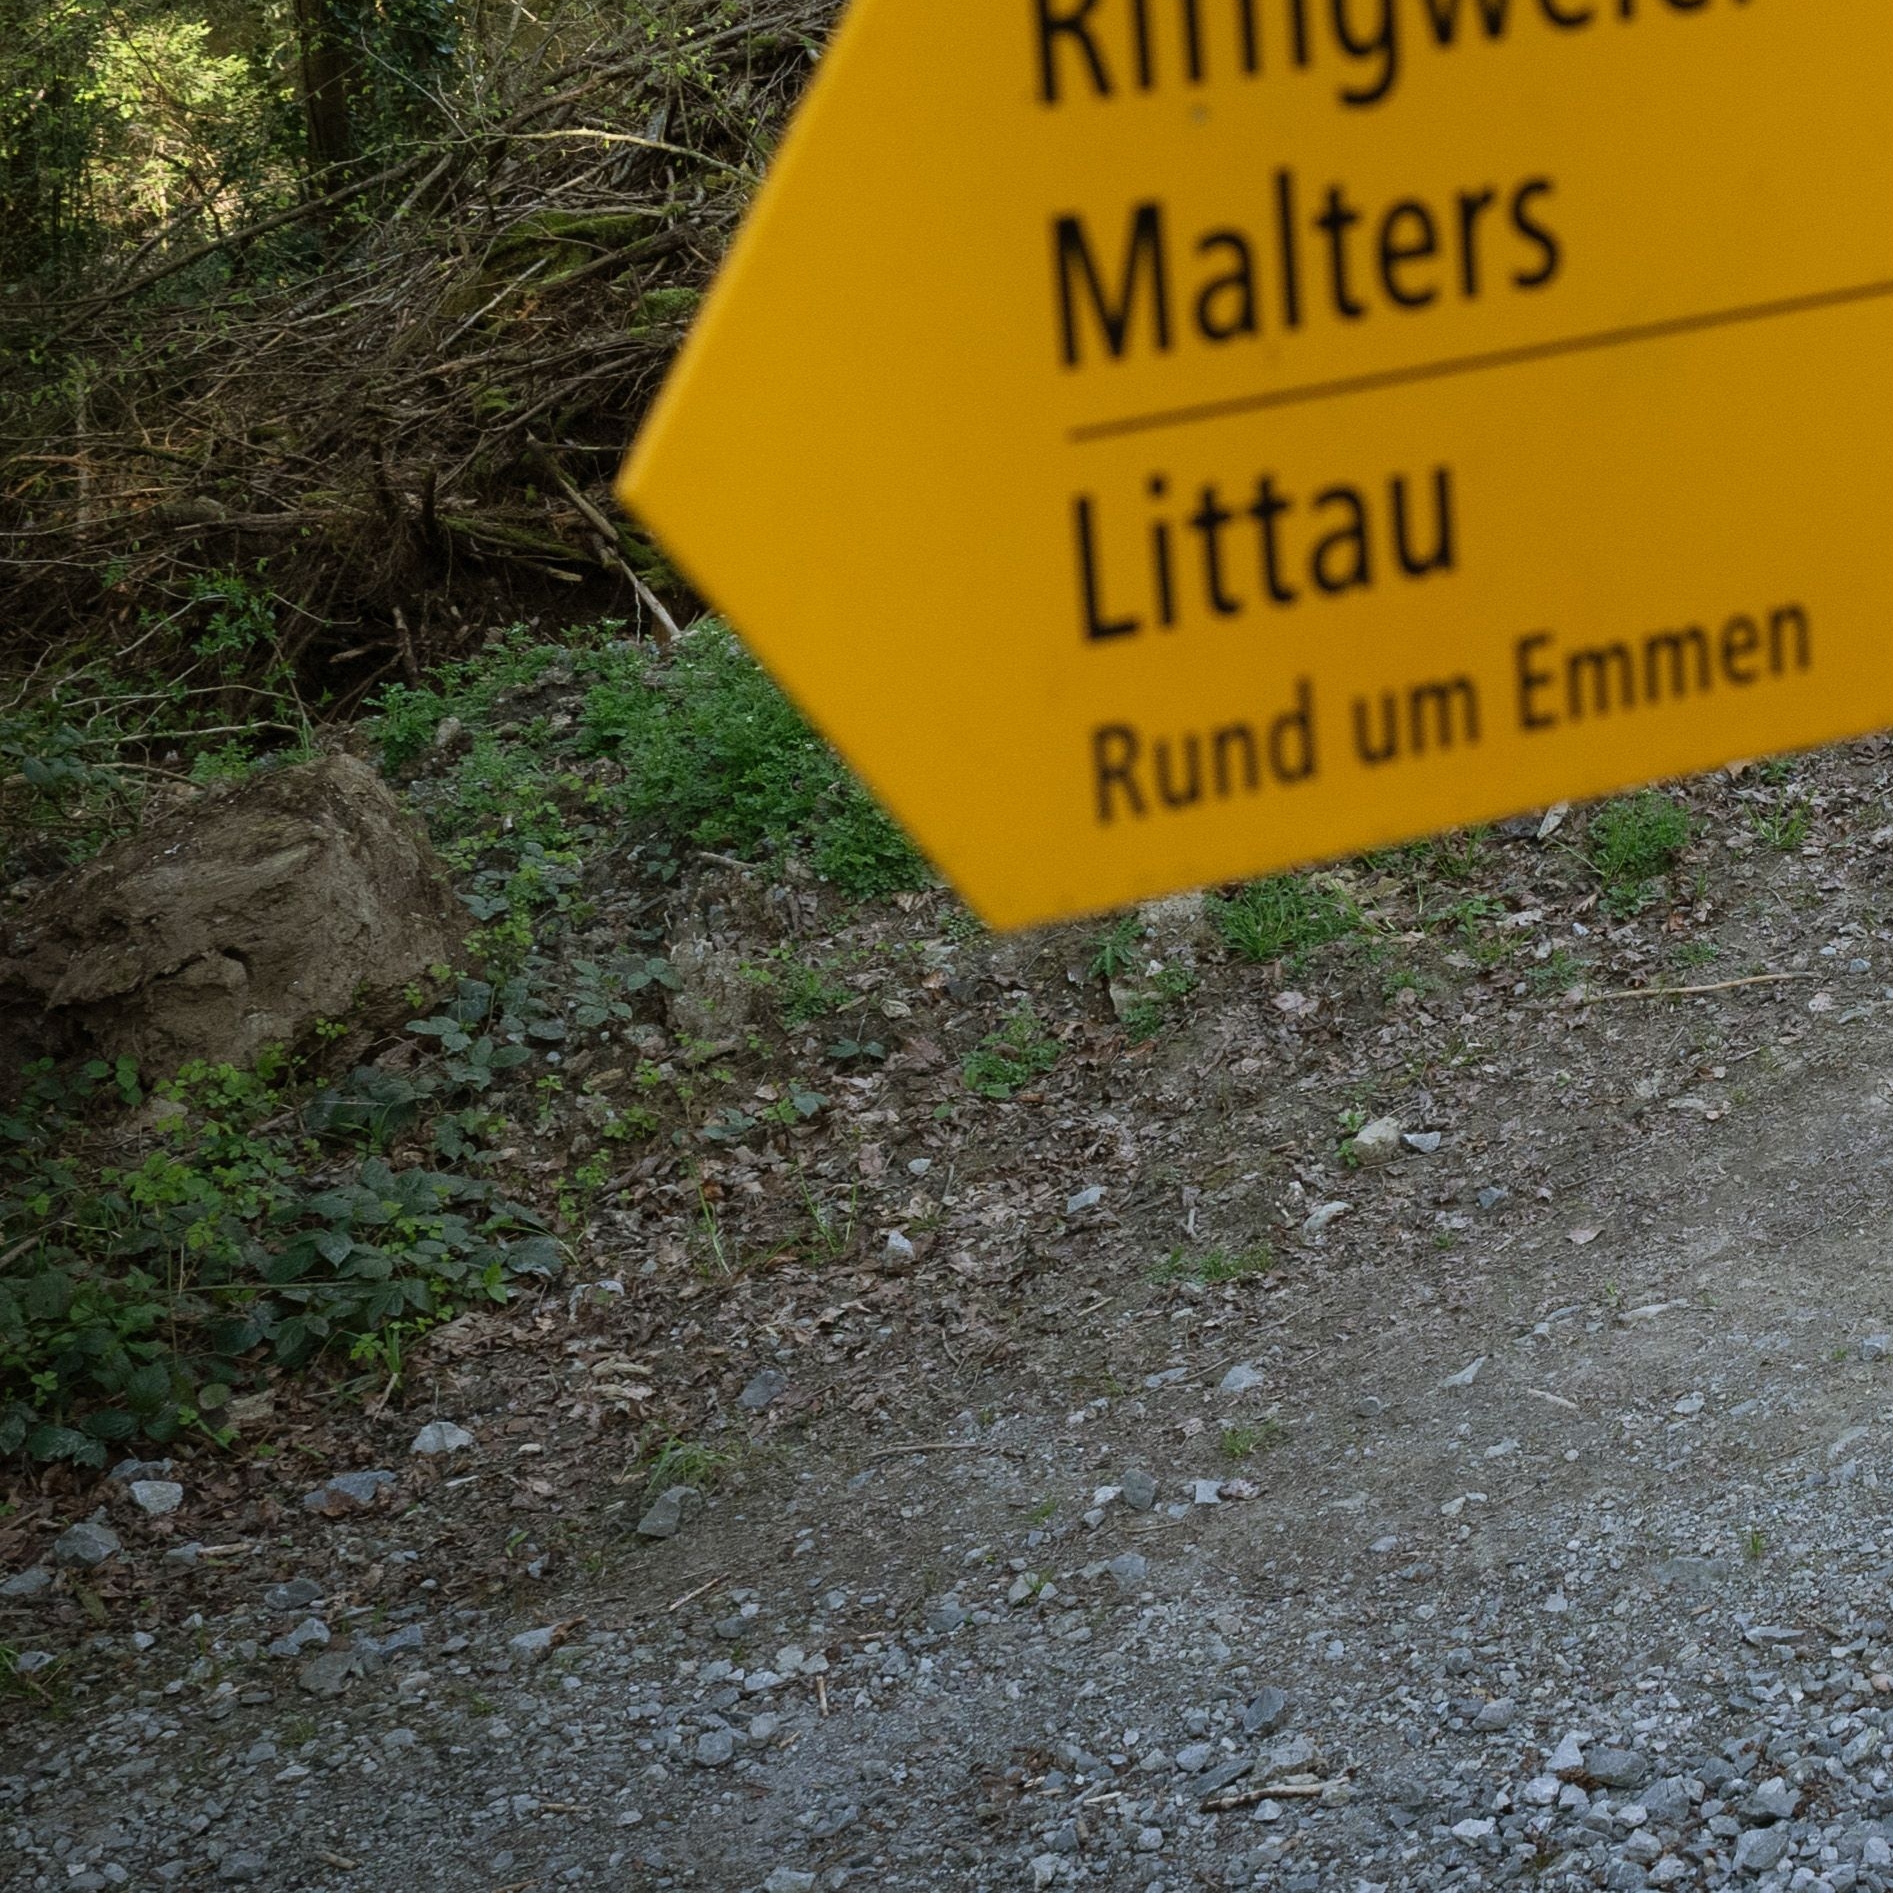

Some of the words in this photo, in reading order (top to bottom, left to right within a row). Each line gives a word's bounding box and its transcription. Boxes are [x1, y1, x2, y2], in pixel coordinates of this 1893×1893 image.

[1050, 167, 1563, 370] Malters
[1073, 465, 1457, 646] Littau
[1091, 681, 1317, 821] Rund
[1353, 675, 1479, 767] um
[1514, 603, 1811, 733] Emmen
